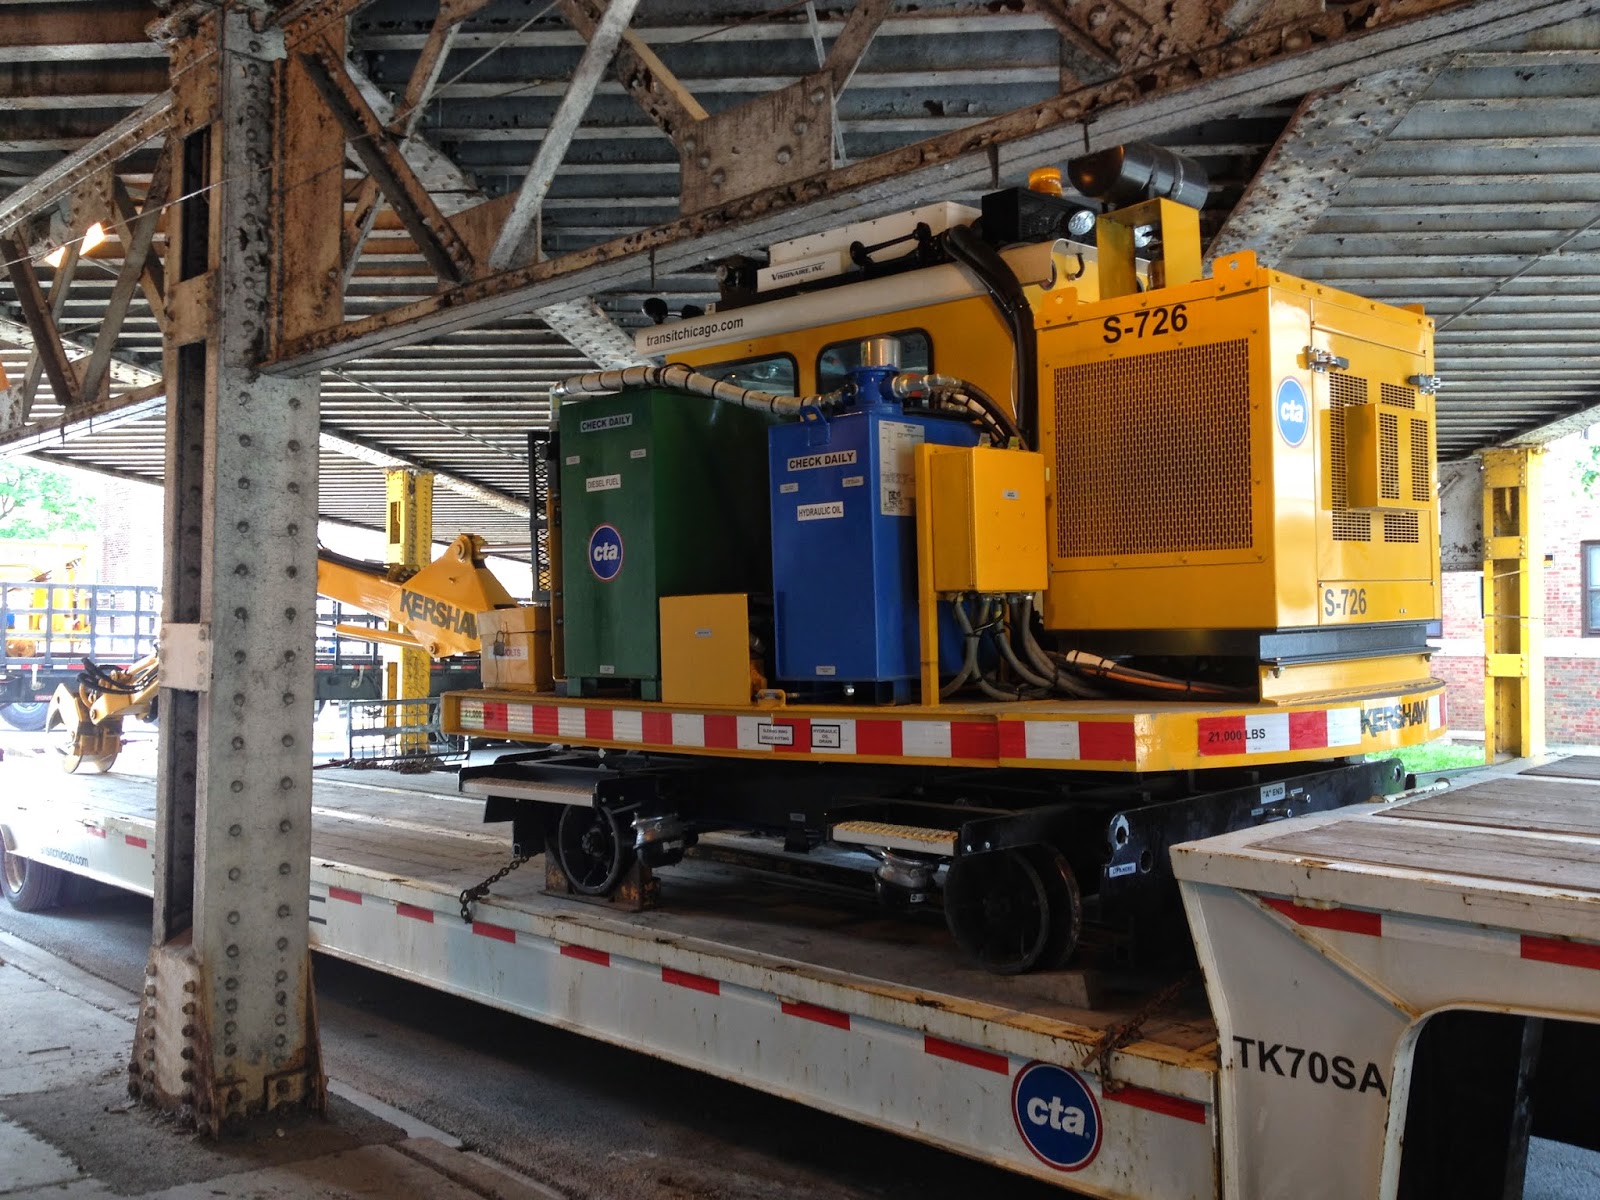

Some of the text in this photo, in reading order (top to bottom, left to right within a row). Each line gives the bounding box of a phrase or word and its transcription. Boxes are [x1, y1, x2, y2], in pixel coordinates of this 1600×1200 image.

[646, 317, 744, 347] transitchicago.com
[1103, 304, 1188, 344] S-726
[581, 415, 631, 431] CHECK DAILY
[1280, 400, 1304, 424] cta
[789, 452, 854, 469] CHECK DAILY
[588, 477, 619, 489] DIESEL FUEL
[798, 505, 842, 518] HYDRAULIC OIL
[593, 542, 618, 562] cta
[400, 588, 478, 641] KERSHA
[1324, 588, 1367, 617] S-726
[1360, 699, 1428, 738] KERSHAW
[1208, 728, 1267, 743] 21,000 LBS
[1262, 789, 1271, 798] "A"
[1272, 787, 1283, 796] END
[1232, 1036, 1388, 1098] TK70SA
[1026, 1096, 1086, 1139] cta
